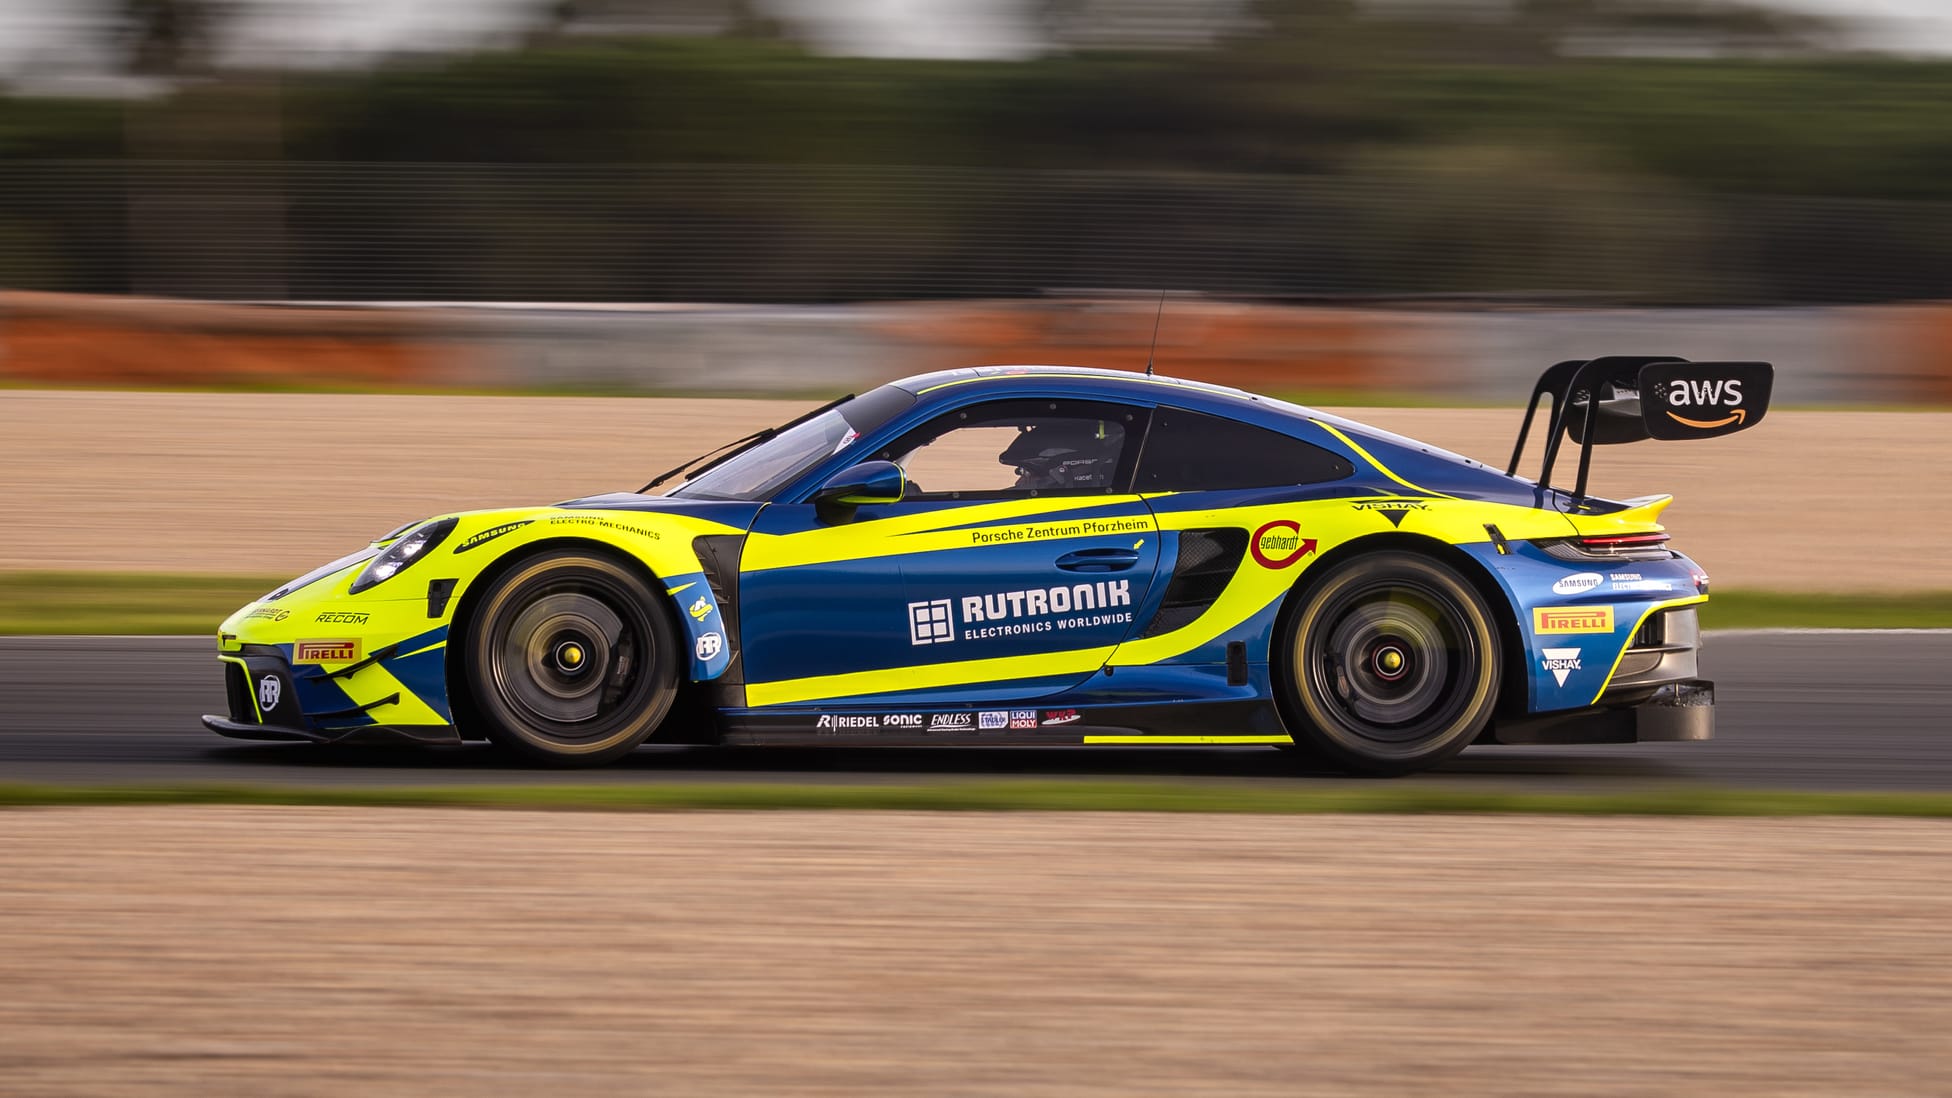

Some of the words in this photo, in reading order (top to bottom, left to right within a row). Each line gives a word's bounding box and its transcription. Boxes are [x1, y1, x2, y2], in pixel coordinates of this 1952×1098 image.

[1669, 379, 1743, 406] aws
[462, 522, 527, 548] SAMSUNG
[972, 530, 1024, 544] Porsche
[1026, 525, 1080, 539] Zentrum
[1083, 519, 1149, 534] Pforzheim
[1260, 535, 1299, 551] gebhardt
[1558, 578, 1600, 588] SAMSUNG
[962, 579, 1131, 623] RUTRONIK
[315, 612, 370, 625] RECOM
[1541, 611, 1607, 630] PIRELLI
[964, 621, 1052, 640] ELECTRONICS
[1057, 612, 1133, 630] WORLDWIDE
[297, 642, 355, 660] PIRELLI
[1541, 659, 1581, 670] VISHAY
[838, 716, 879, 728] RIEDEL
[883, 714, 923, 726] SONIC
[930, 713, 972, 726] ENDLESS
[1011, 711, 1036, 720] LIQUI
[1011, 719, 1036, 729] MOLY
